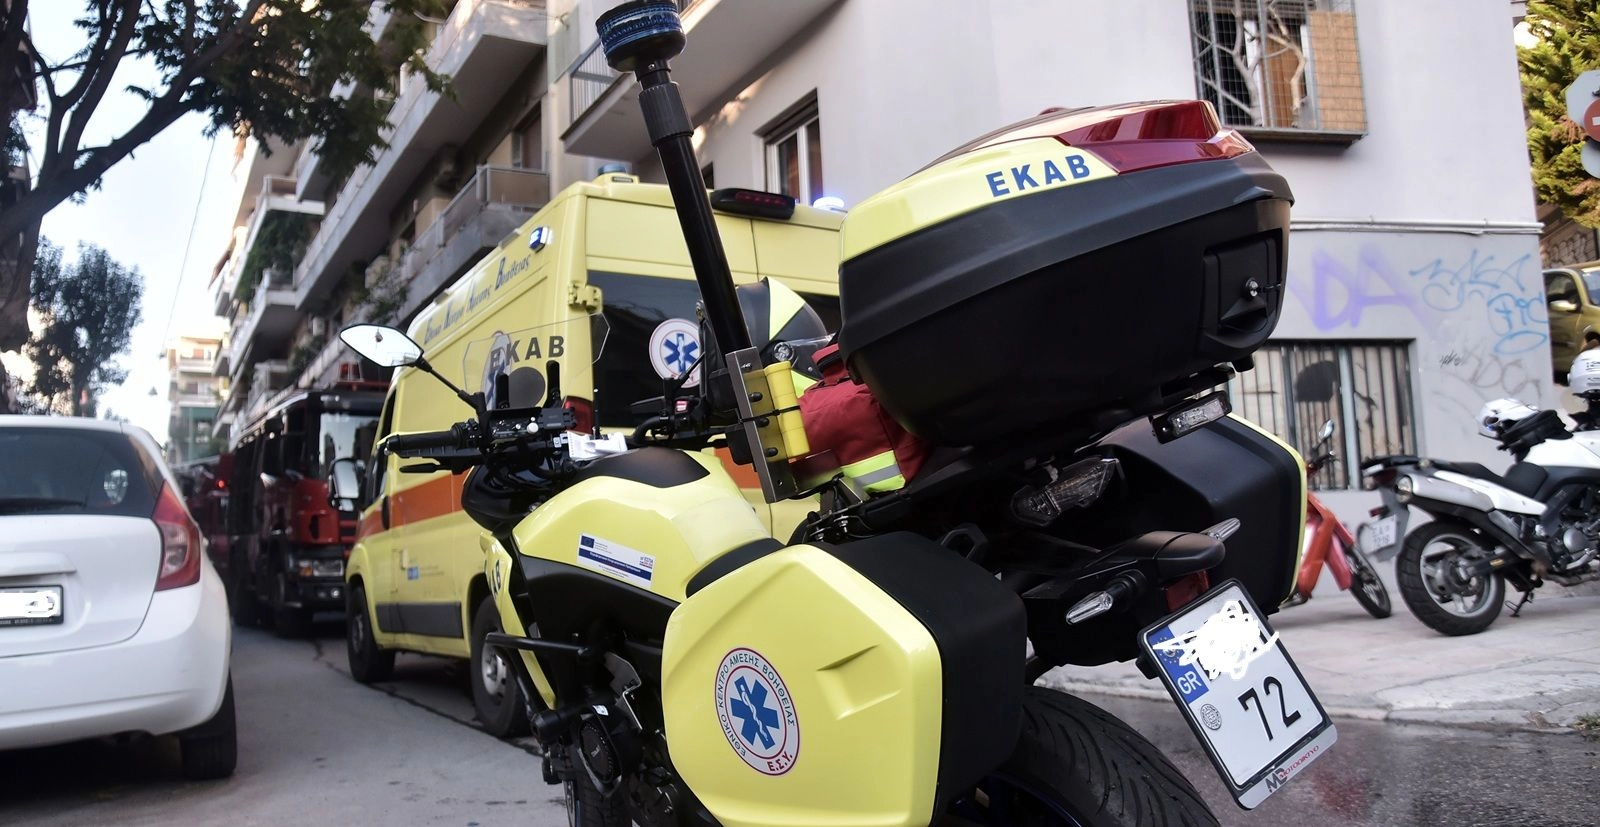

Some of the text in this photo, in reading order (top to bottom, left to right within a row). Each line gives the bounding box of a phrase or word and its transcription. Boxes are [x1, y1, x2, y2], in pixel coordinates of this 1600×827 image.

[716, 653, 796, 757] ΕΘΝΙΚΟ ΚΕΝΤΡΟ ΑΜΕΣΗΣ ΒΟΗΘΕΙΑΣ
[1177, 670, 1203, 695] GR
[1237, 676, 1301, 741] 72
